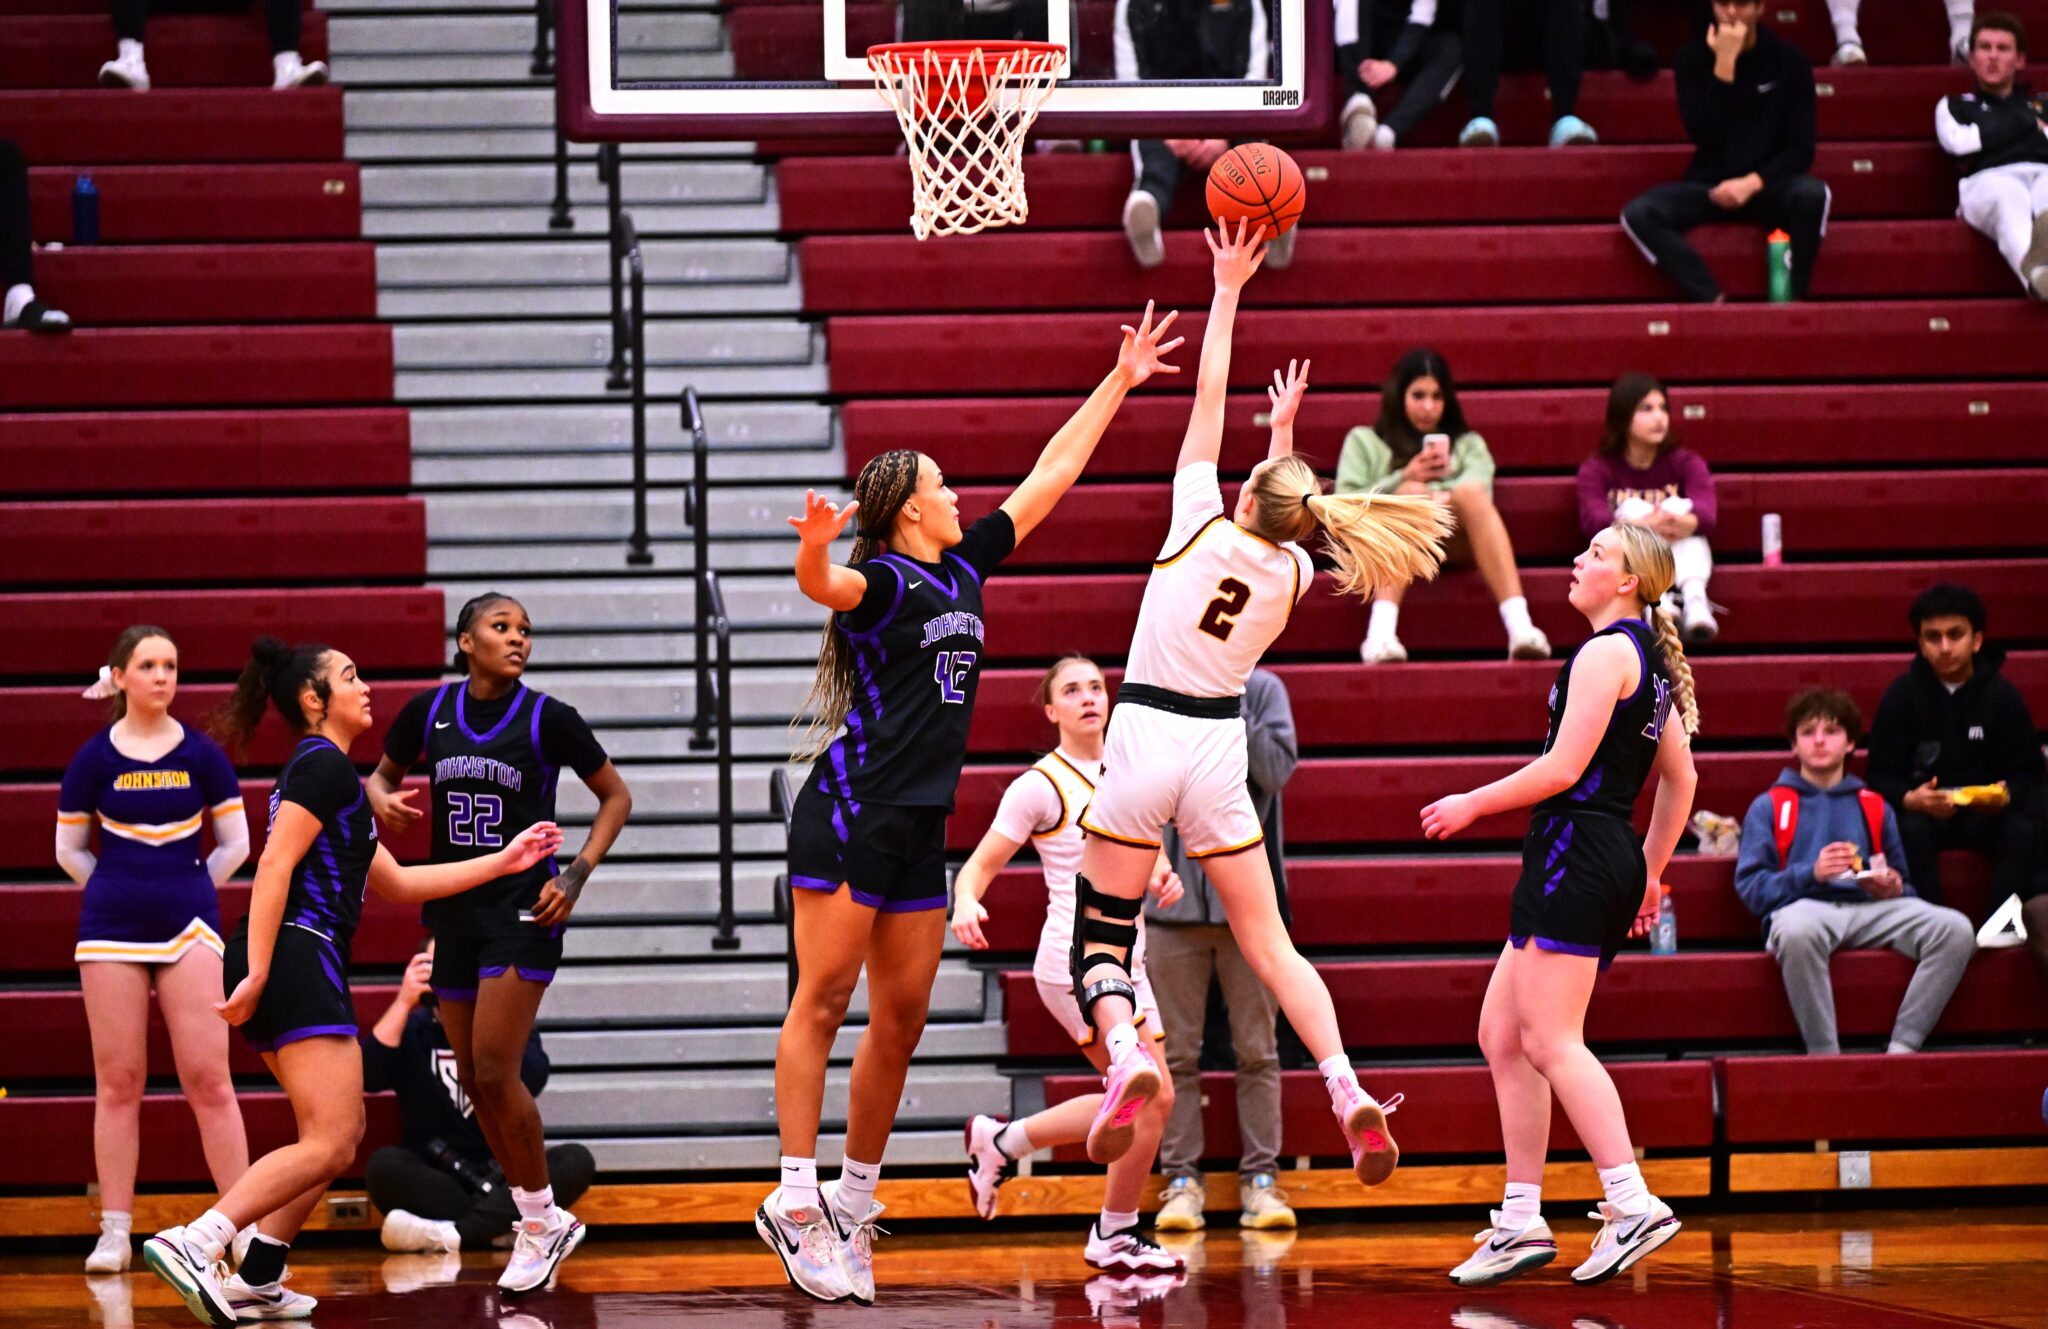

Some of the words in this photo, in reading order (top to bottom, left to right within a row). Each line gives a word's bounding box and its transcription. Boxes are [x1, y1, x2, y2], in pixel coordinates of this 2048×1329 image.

[1220, 158, 1246, 186] 1000
[1197, 576, 1252, 643] 2
[934, 651, 977, 704] 42
[113, 769, 191, 792] JOHNSTON
[435, 755, 522, 792] JOHNSTON
[447, 791, 503, 847] 22
